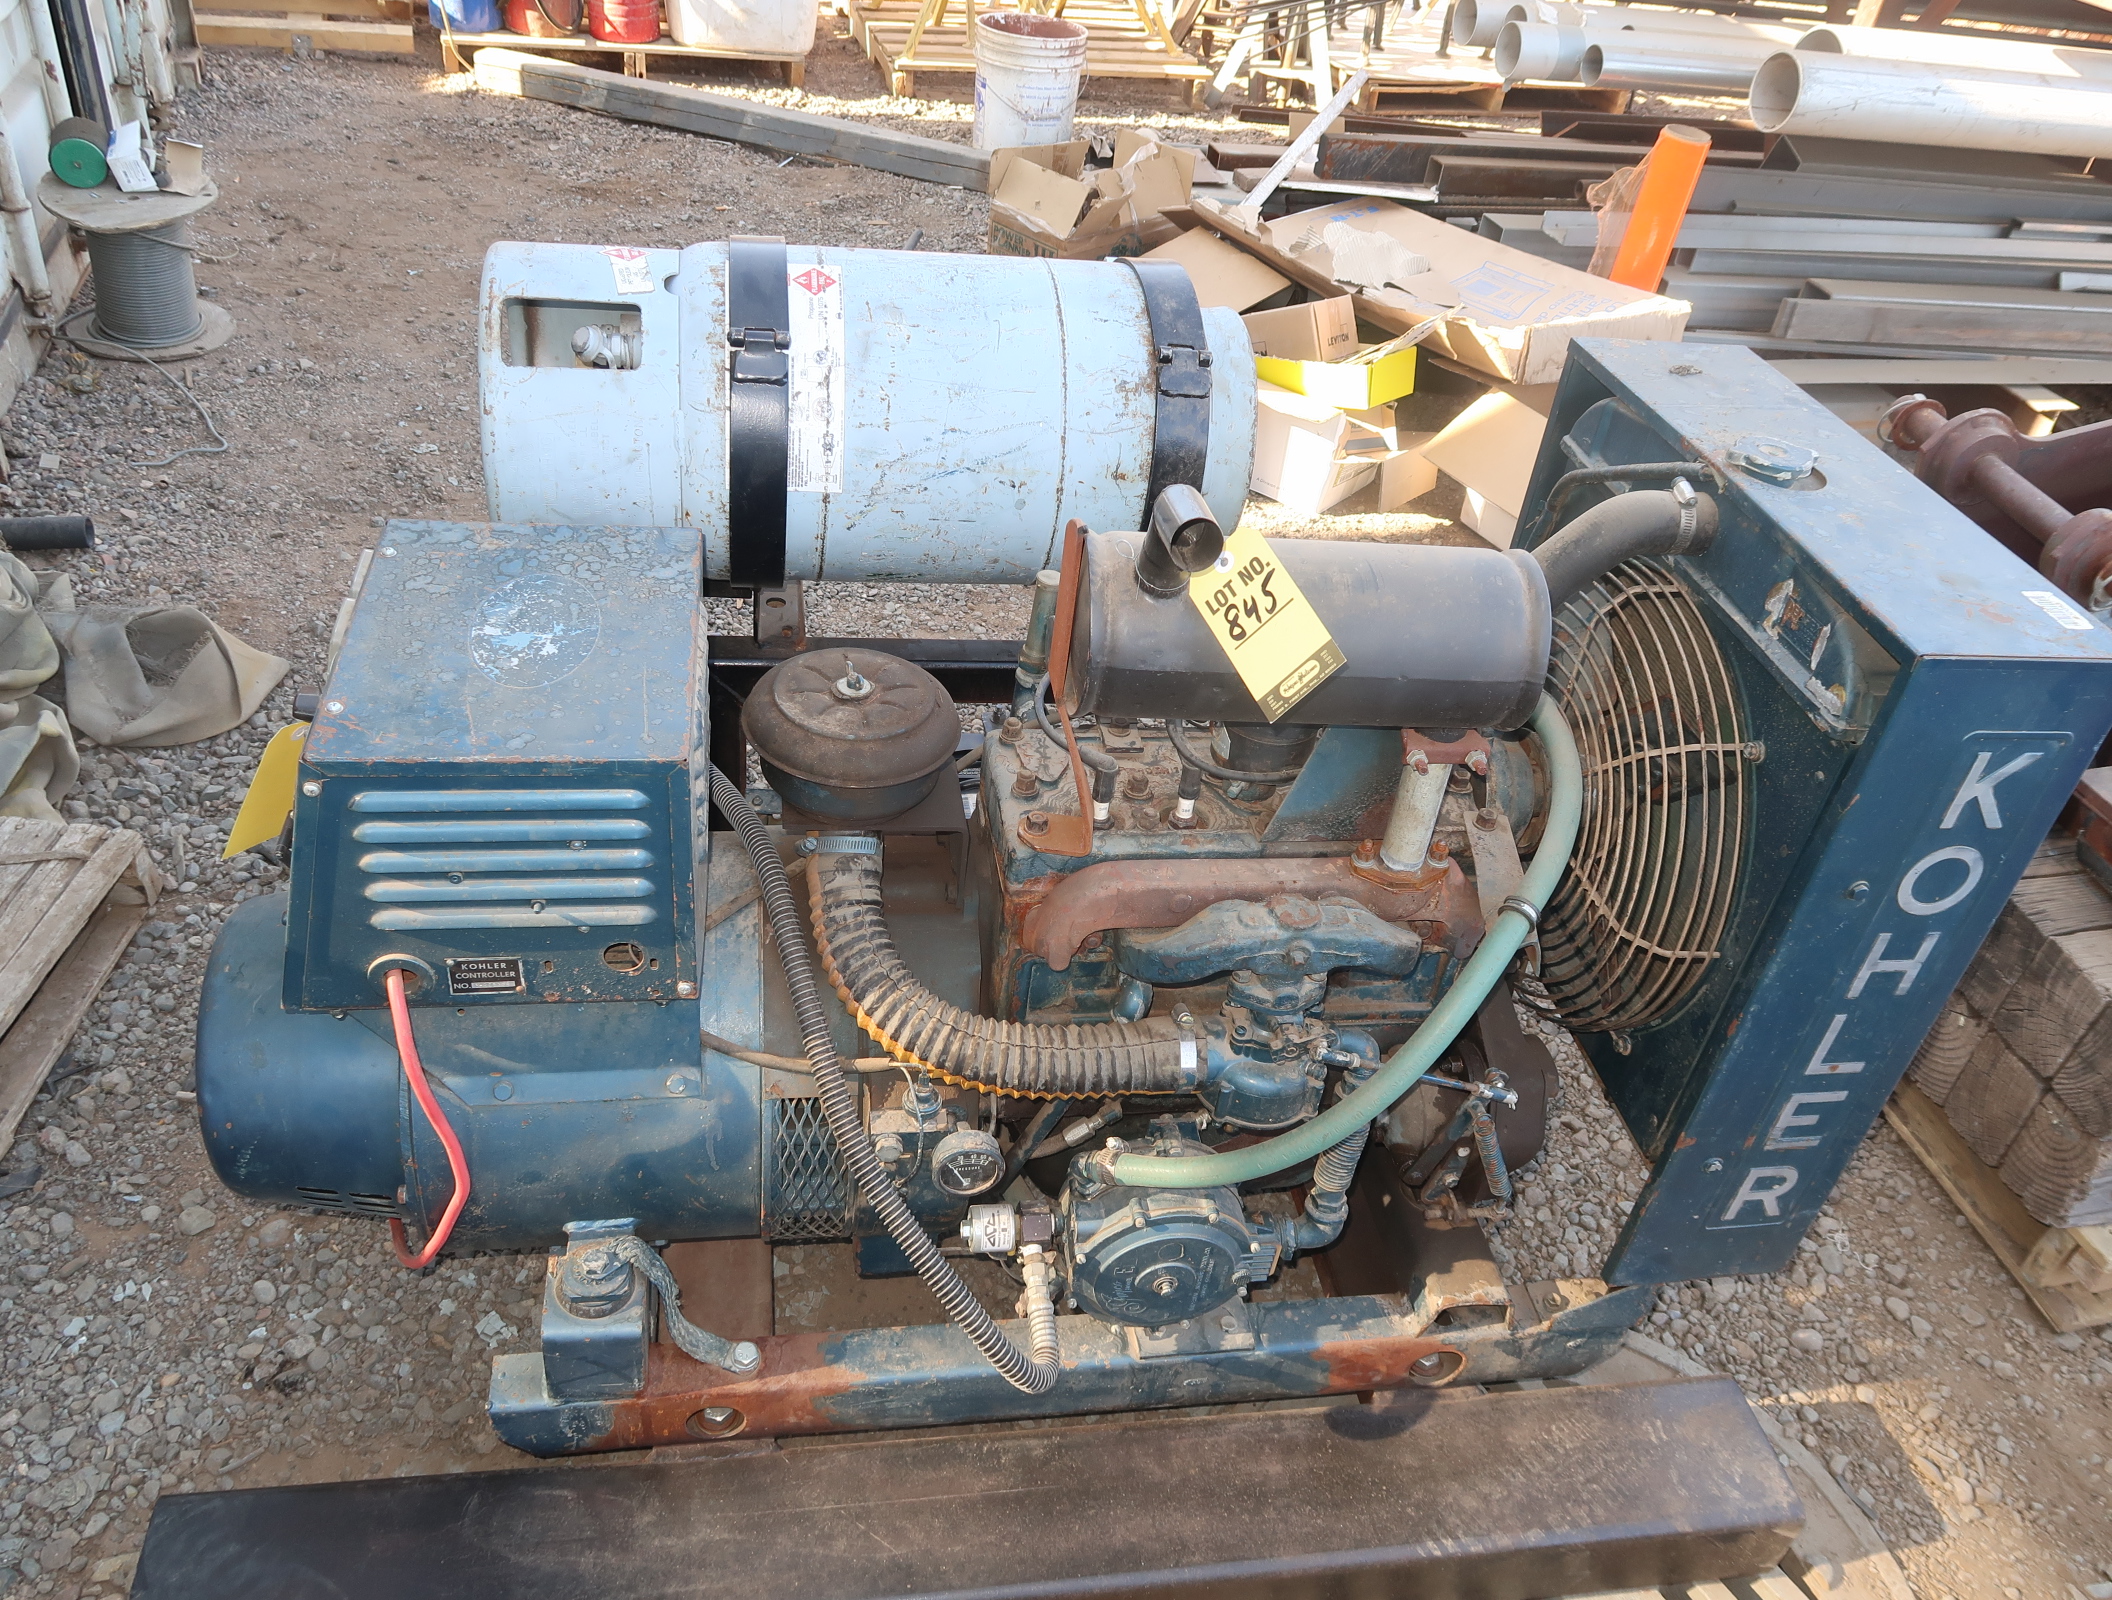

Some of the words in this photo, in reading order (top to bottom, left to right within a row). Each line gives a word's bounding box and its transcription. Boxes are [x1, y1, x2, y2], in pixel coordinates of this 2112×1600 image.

[993, 225, 1024, 245] POWER
[993, 236, 1031, 257] PLANNER
[808, 296, 816, 320] Propane
[1327, 332, 1350, 348] LEVITON
[1204, 579, 1238, 616] LOT
[1237, 556, 1271, 587] NO.
[1223, 567, 1278, 642] 845
[455, 971, 516, 979] CONTROLLER
[461, 962, 507, 970] KOHLER
[1721, 751, 2045, 1222] KOHLER
